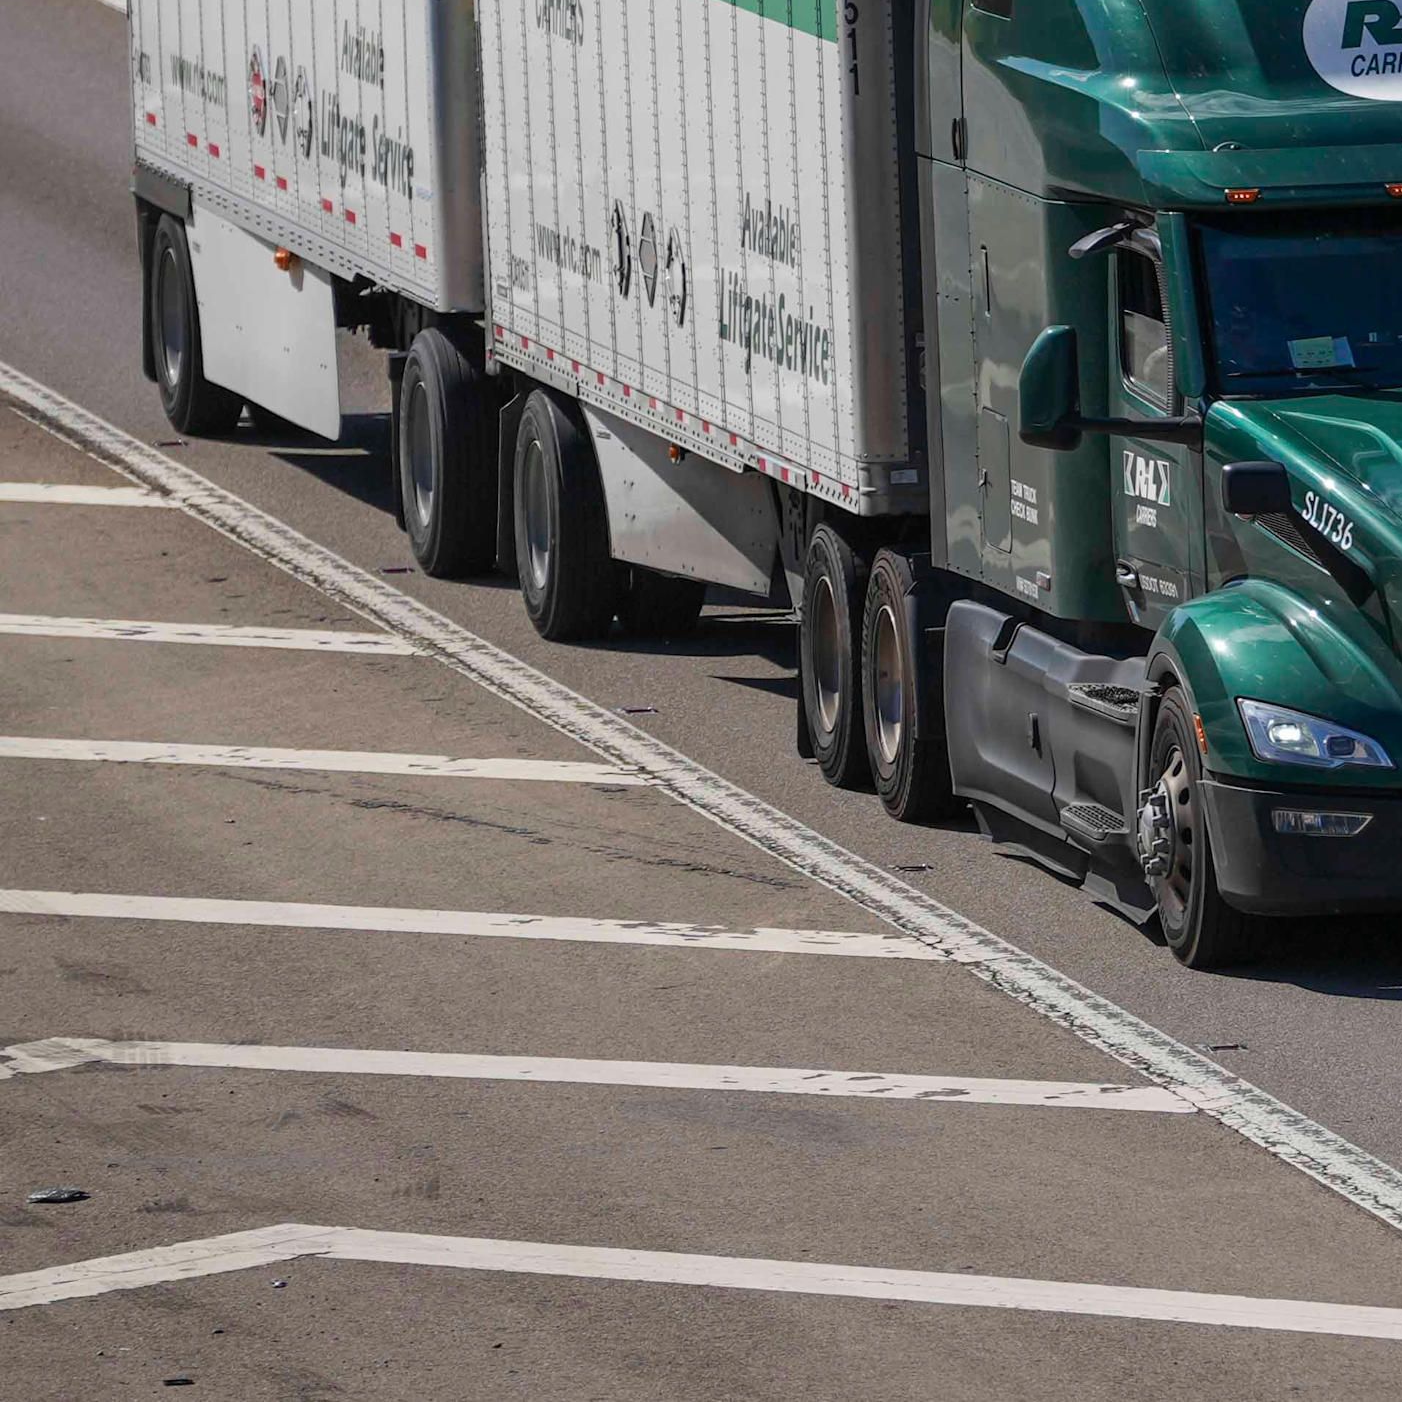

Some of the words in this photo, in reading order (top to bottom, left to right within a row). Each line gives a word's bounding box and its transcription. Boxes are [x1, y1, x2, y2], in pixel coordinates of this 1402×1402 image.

[340, 19, 385, 90] Available
[320, 89, 367, 189] Liftgate
[371, 113, 415, 200] Service
[740, 192, 798, 269] Available
[719, 268, 775, 375] Liftgate
[776, 292, 830, 386] Service
[1301, 490, 1354, 551] SL1736
